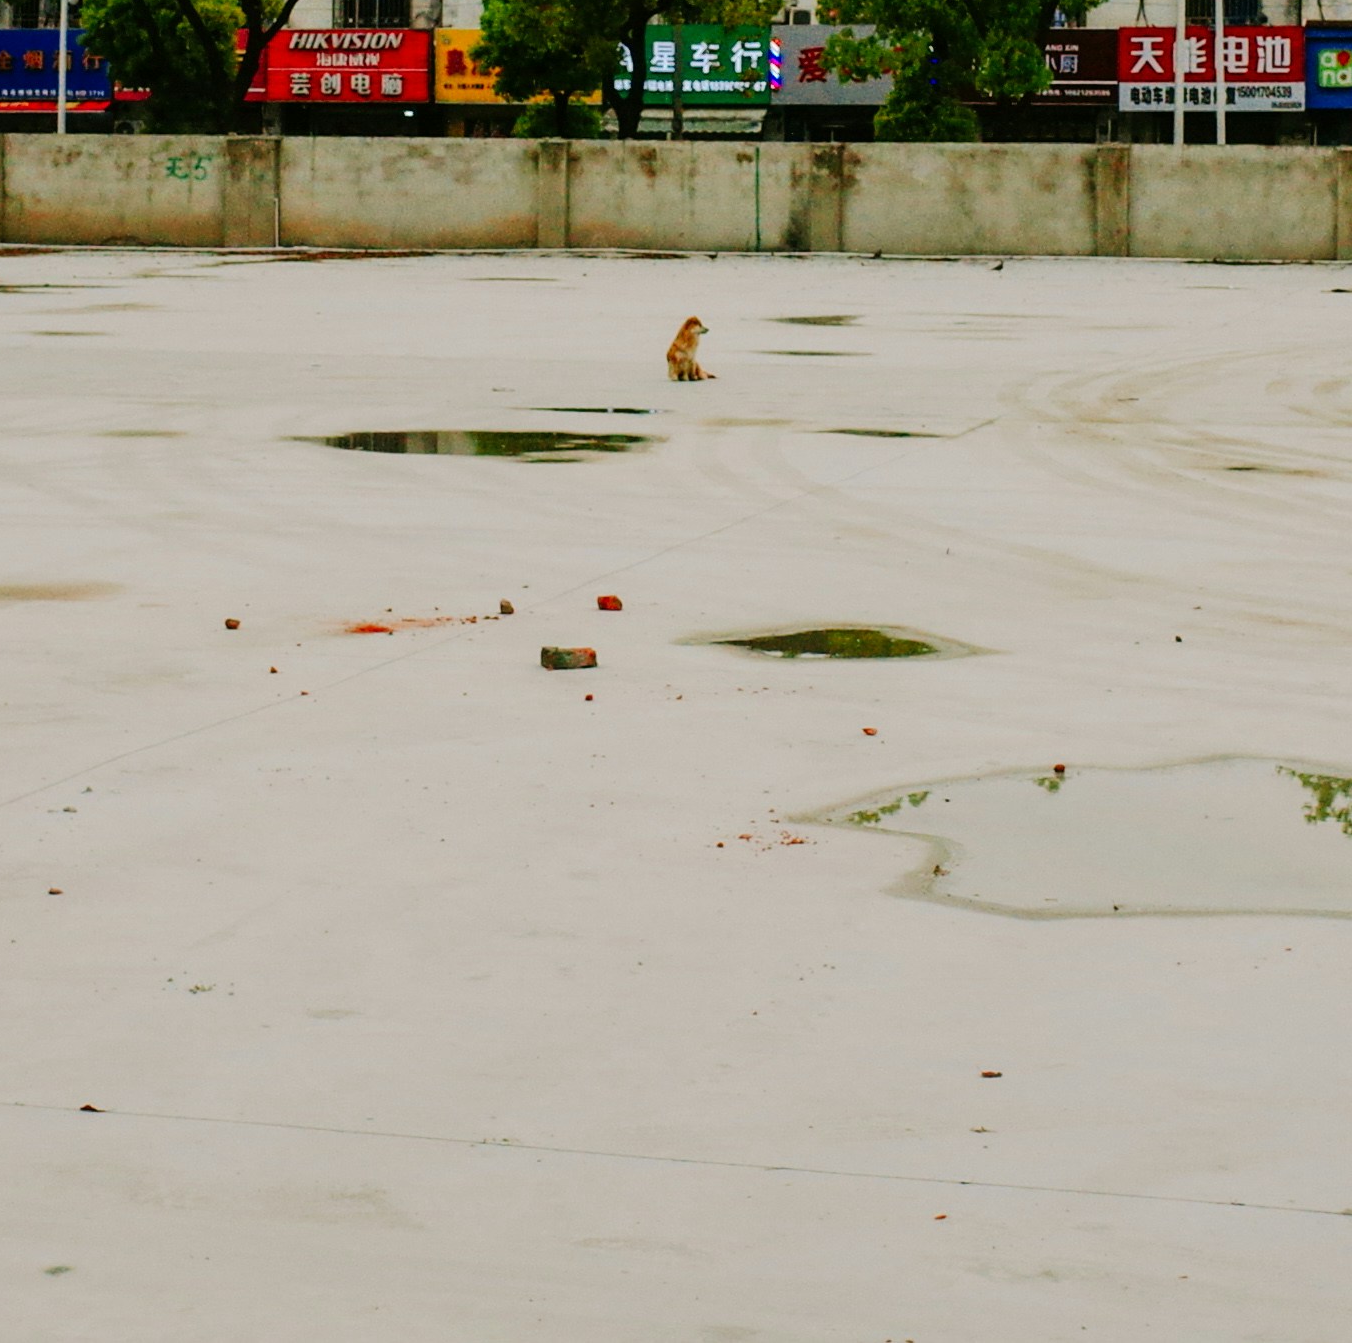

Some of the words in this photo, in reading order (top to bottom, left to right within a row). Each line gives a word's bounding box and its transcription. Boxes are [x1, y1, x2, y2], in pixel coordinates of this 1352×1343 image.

[289, 32, 403, 50] HIKVISION
[1130, 36, 1291, 73] 天能电池
[290, 72, 402, 96] 芸创电脑
